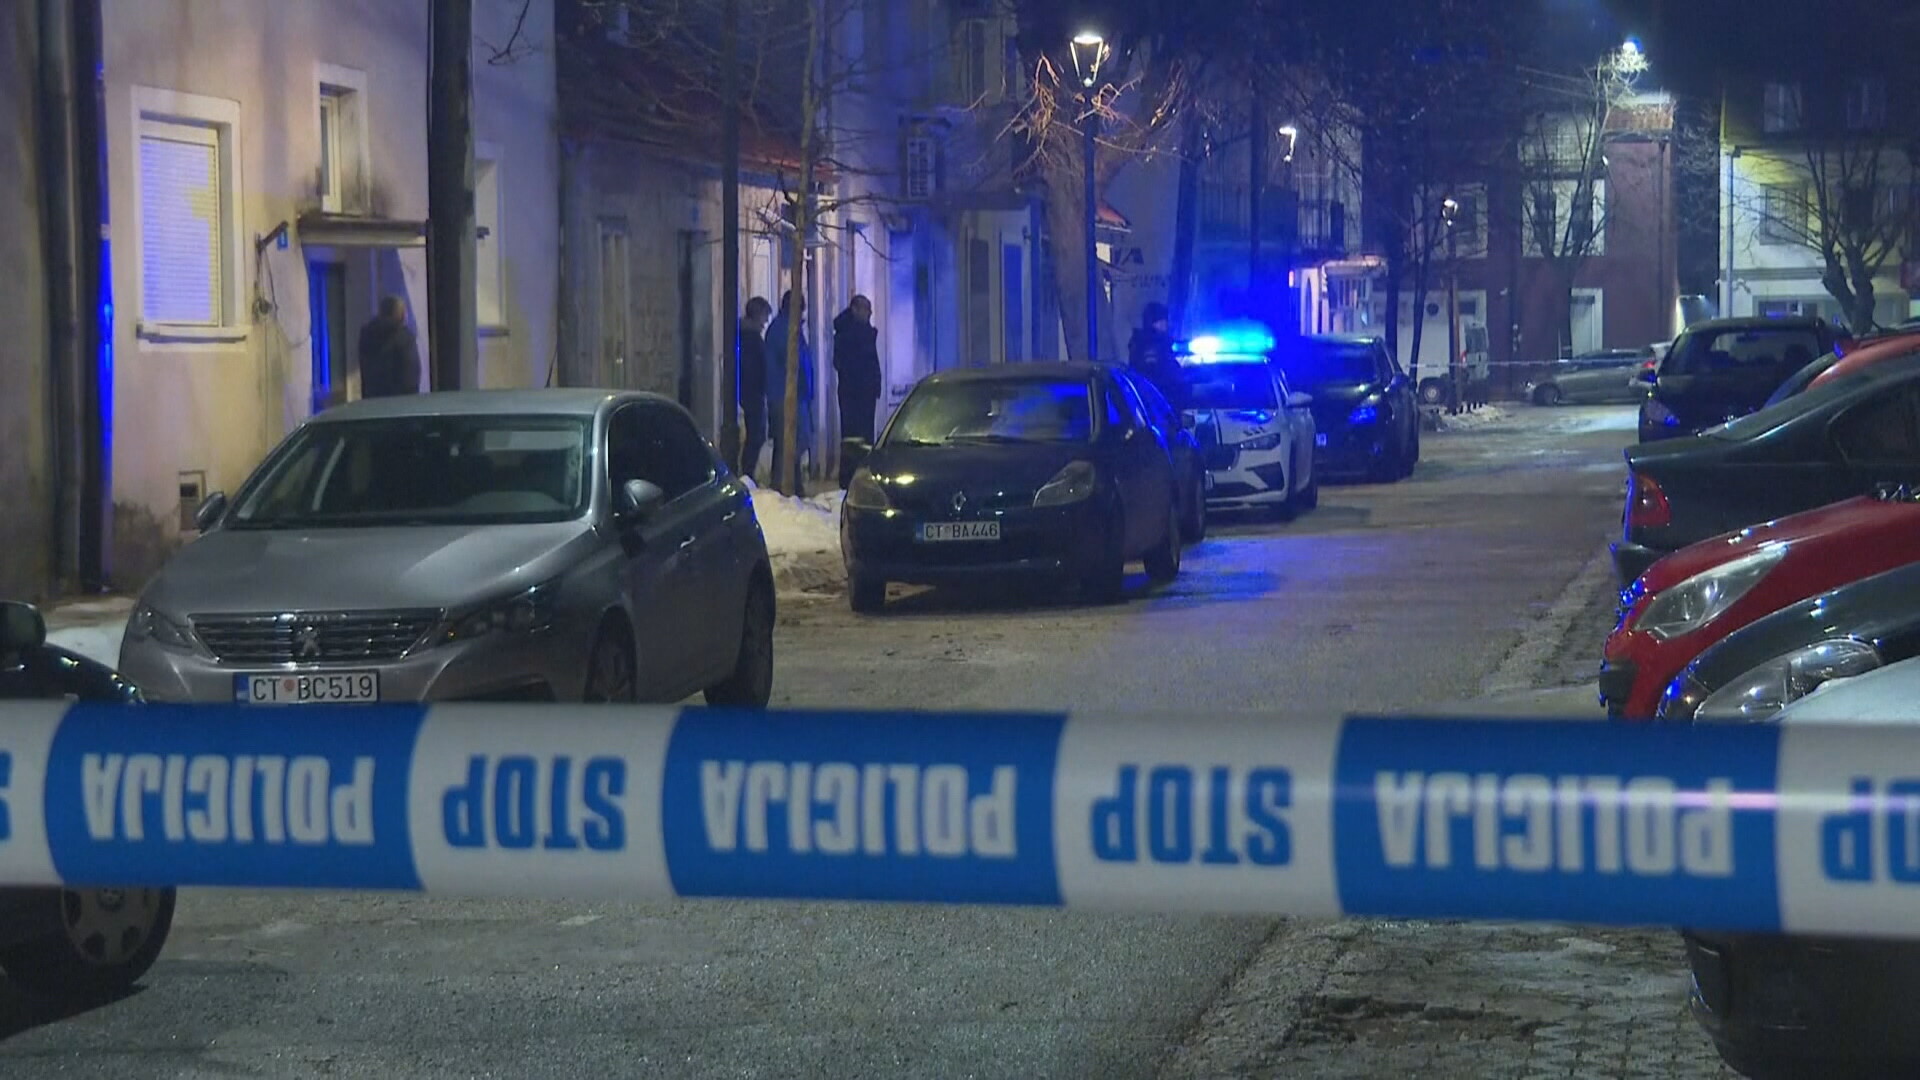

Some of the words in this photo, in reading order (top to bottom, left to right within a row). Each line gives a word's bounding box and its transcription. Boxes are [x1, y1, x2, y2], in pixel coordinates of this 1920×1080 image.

[925, 524, 942, 538] CT
[953, 523, 998, 538] BA446
[254, 677, 281, 700] CT
[297, 676, 372, 700] BC519
[81, 753, 374, 844] POLICIJA
[442, 755, 627, 850] STOP
[700, 758, 1018, 858] POLICIJA
[1091, 763, 1293, 866] STOP
[1375, 770, 1735, 878] POLICIJA
